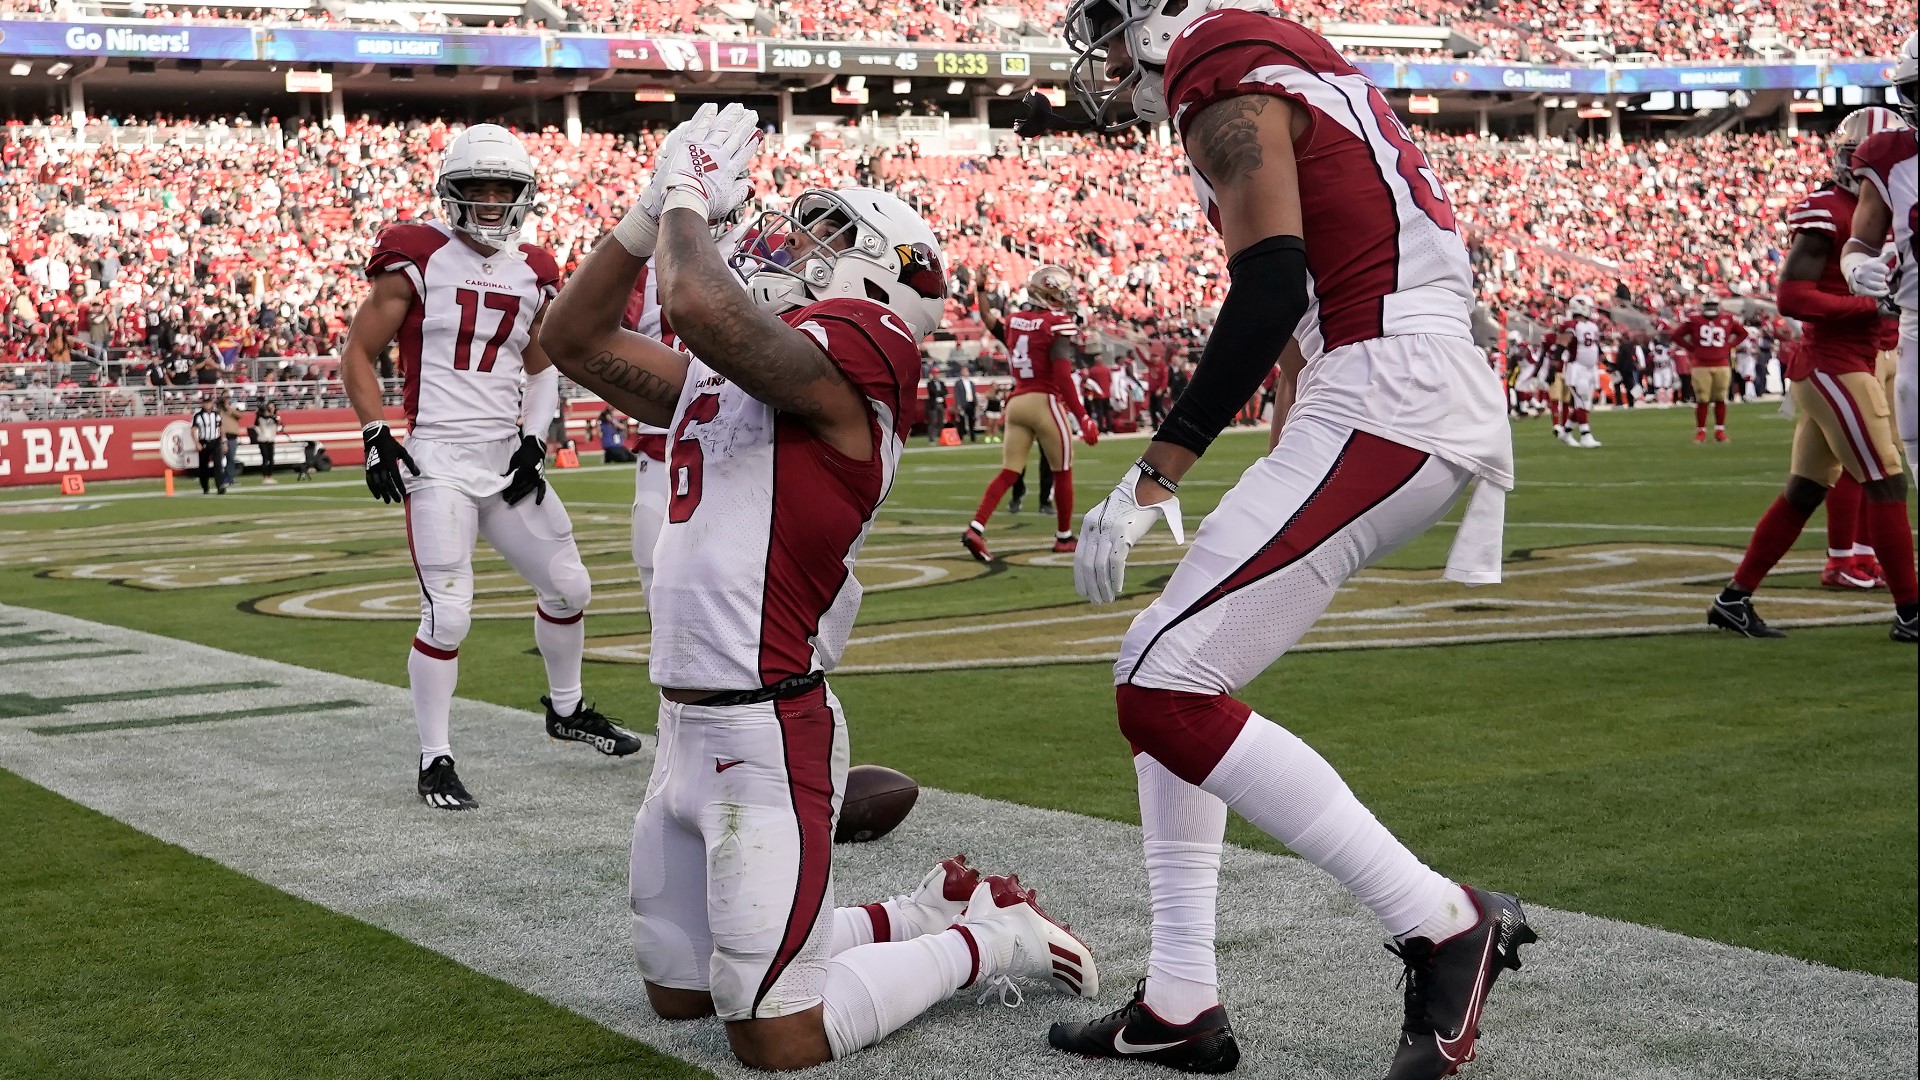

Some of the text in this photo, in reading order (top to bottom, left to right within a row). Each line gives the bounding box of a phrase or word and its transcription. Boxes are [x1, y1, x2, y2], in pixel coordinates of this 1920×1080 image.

[66, 27, 190, 53] Go Niners!
[358, 39, 439, 55] BUD LIGHT
[638, 47, 648, 60] 3
[729, 47, 748, 65] 17
[772, 49, 811, 67] 2ND
[828, 50, 841, 68] 8
[895, 52, 918, 70] 45
[934, 52, 988, 74] 13:33
[1503, 69, 1571, 88] Go Niners!
[1680, 71, 1740, 84] BUD LIGHT
[688, 144, 704, 178] adidas
[465, 279, 513, 290] CARDINALS
[453, 287, 522, 373] 17
[1699, 325, 1726, 347] 93
[1011, 334, 1034, 379] 4
[22, 424, 114, 474] BAY
[669, 392, 721, 525] 6
[68, 477, 81, 491] G
